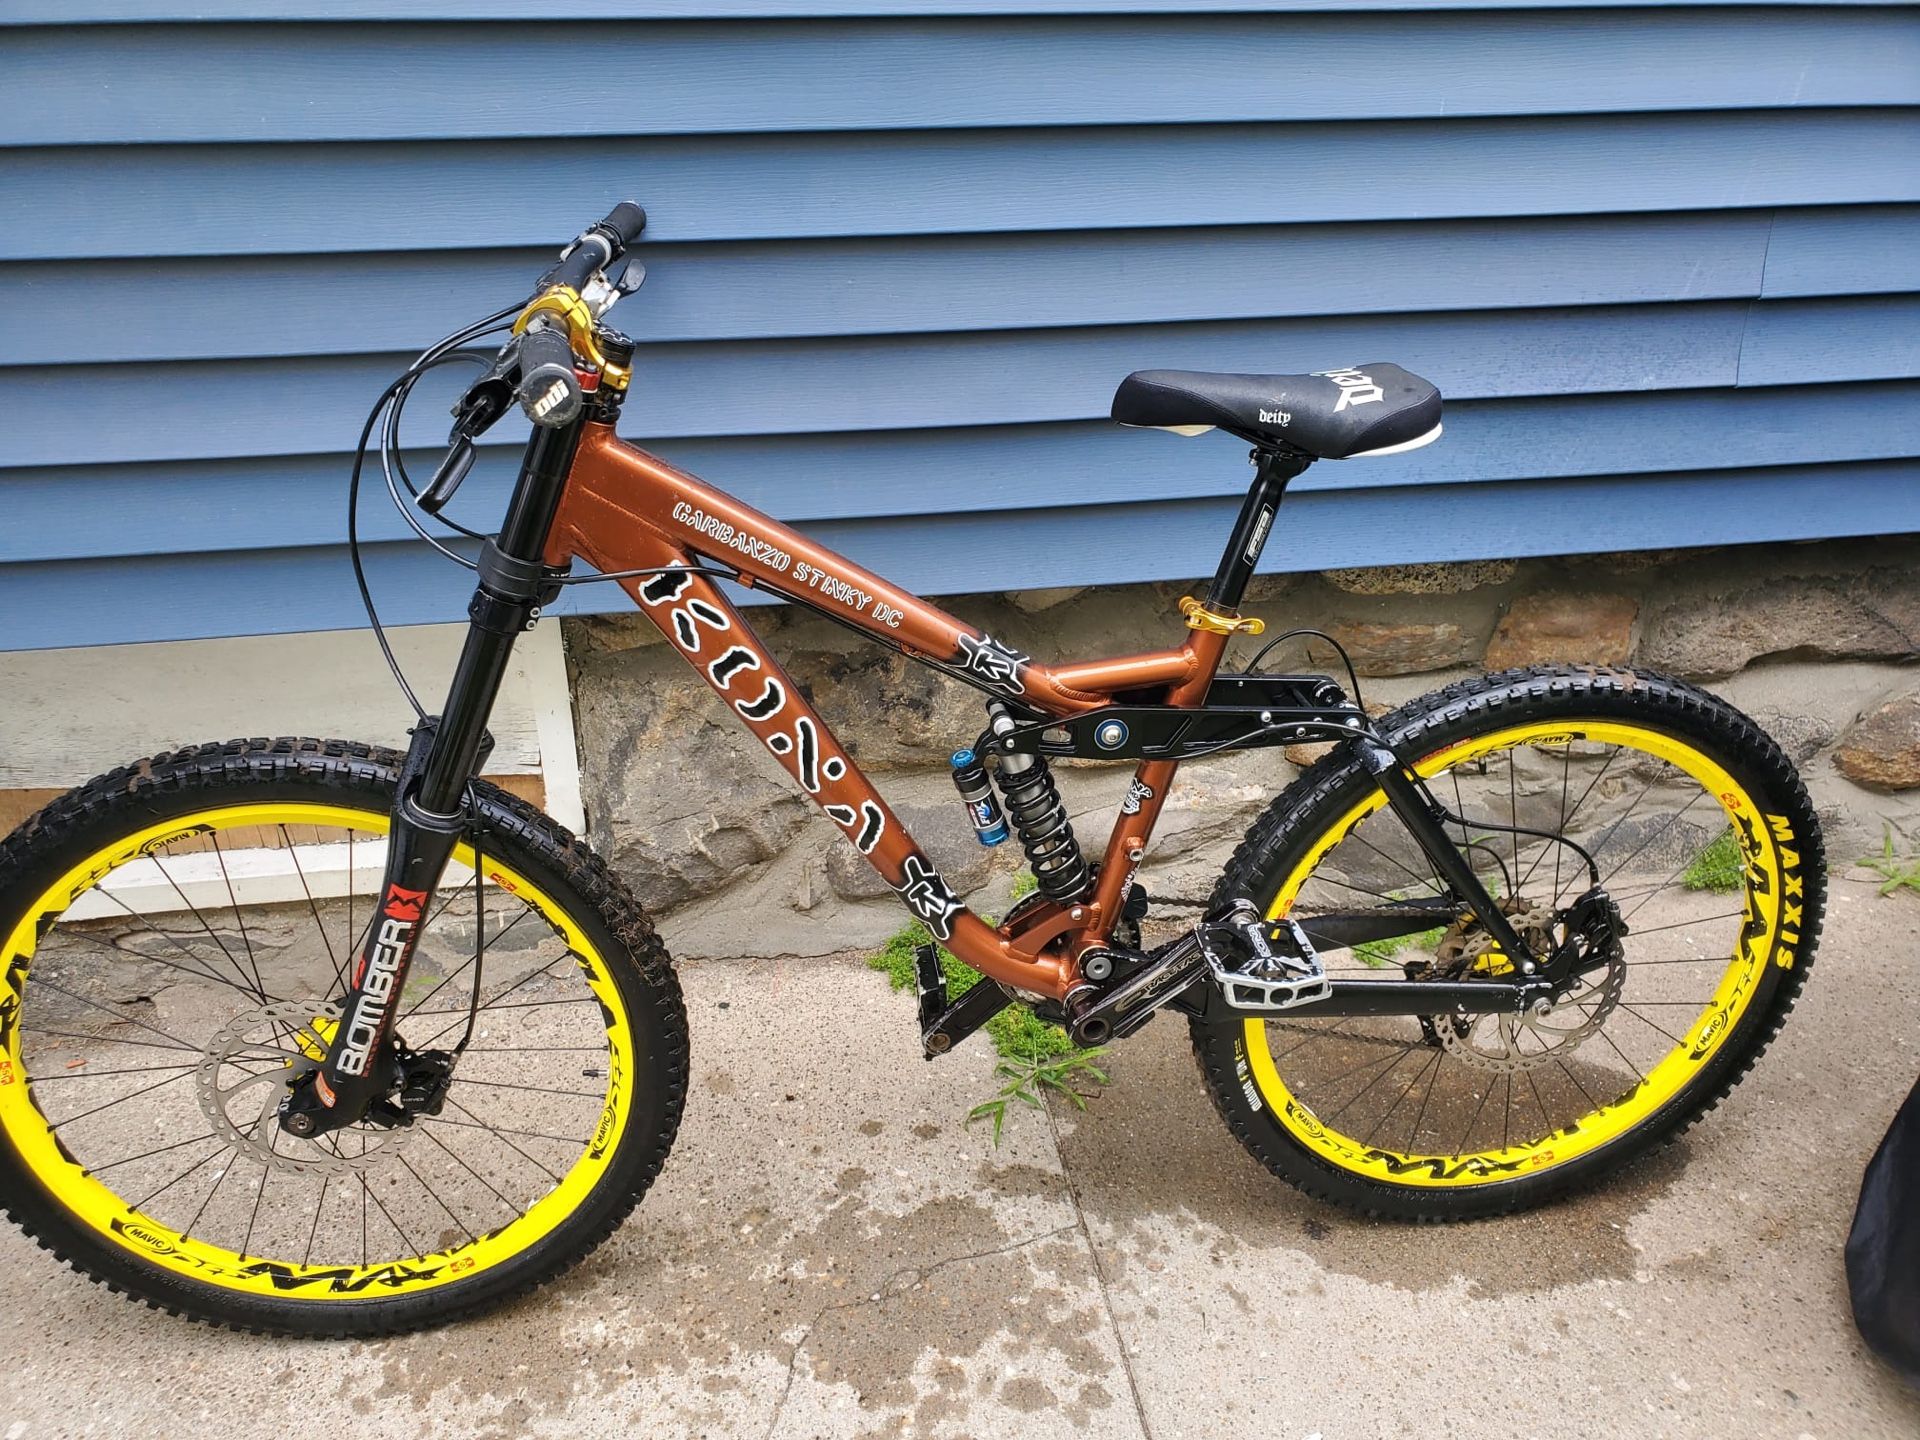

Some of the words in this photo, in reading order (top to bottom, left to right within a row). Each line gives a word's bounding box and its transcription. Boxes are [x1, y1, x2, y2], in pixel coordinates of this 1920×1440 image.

[1259, 408, 1291, 427] deity
[673, 501, 791, 572] GARBANZO
[793, 562, 873, 611] STINKY
[153, 832, 190, 850] MAVIC
[1767, 815, 1802, 970] MAXXIS
[336, 918, 412, 1077] BOMBER
[1701, 1020, 1721, 1046] MAVIC
[598, 1114, 611, 1144] MAVIC
[1297, 1111, 1318, 1131] MAVIC
[130, 1228, 165, 1249] MAVIC
